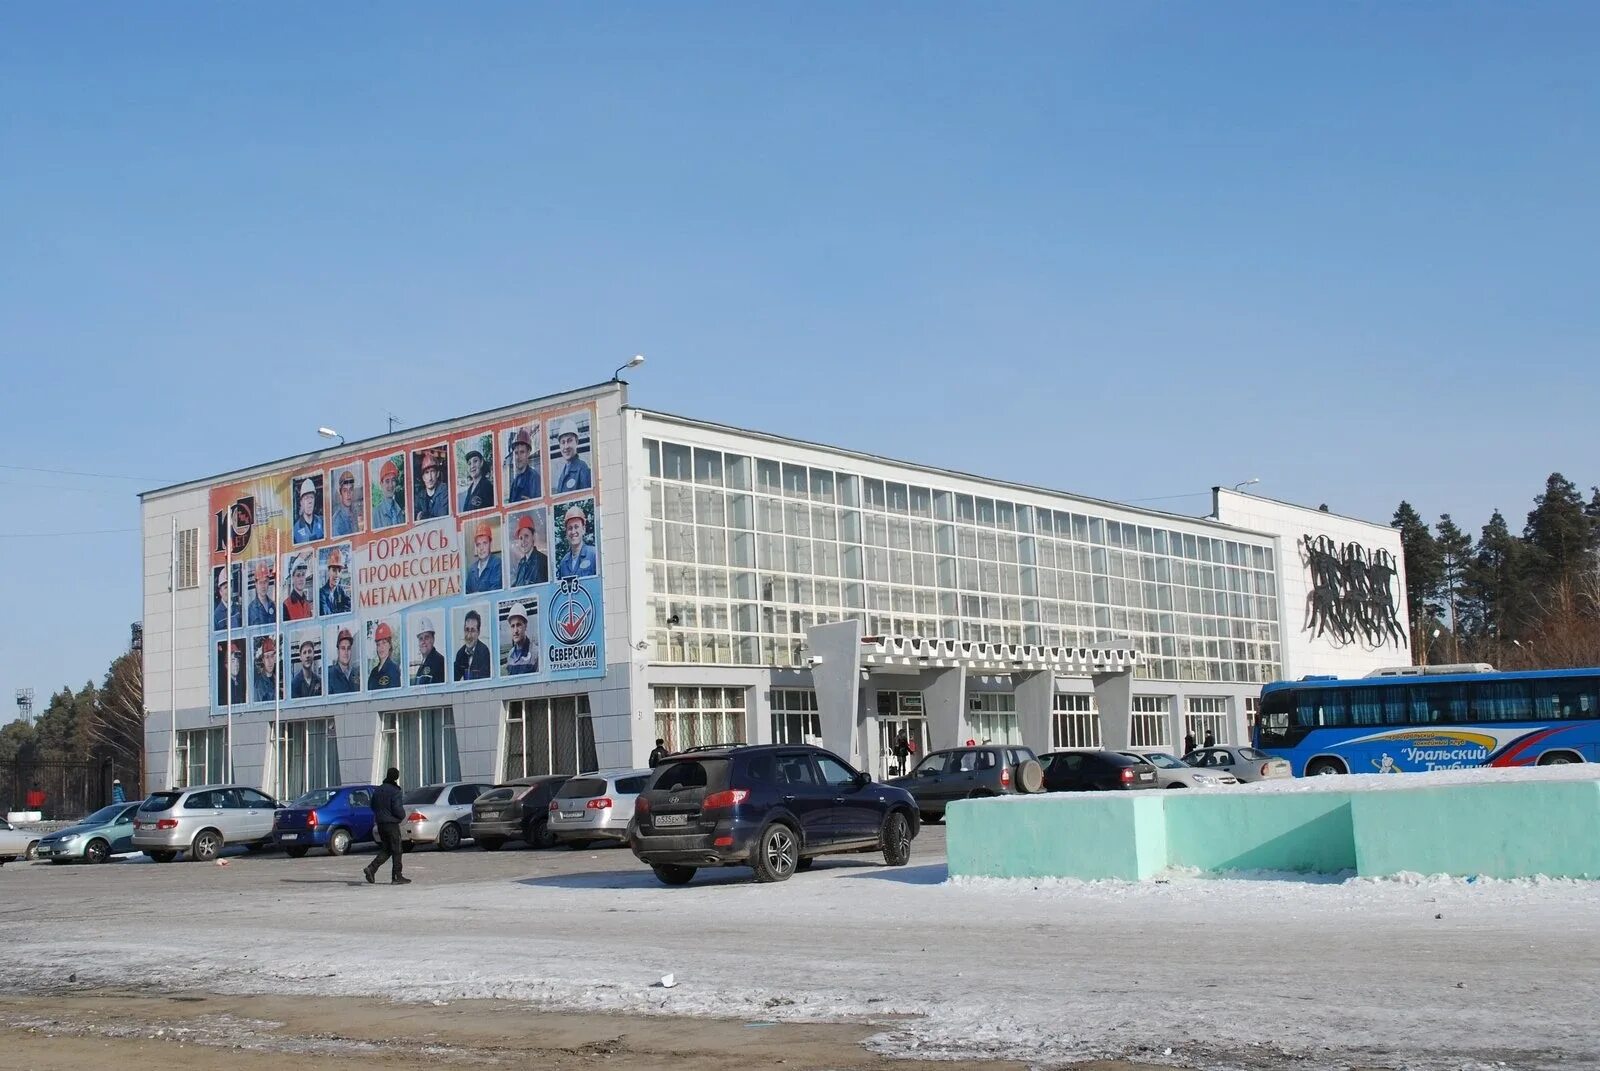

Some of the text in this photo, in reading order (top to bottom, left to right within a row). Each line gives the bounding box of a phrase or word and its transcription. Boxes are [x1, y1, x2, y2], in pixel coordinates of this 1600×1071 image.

[368, 529, 448, 561] ГОРЖУСЬ
[359, 550, 460, 584] ПРОФЕССИЕЙ
[359, 575, 461, 608] МЕТАЛЛУРГА!
[561, 576, 579, 593] СТЗ
[549, 642, 596, 662] СЕВЕРСКИЙ
[550, 660, 597, 670] ТРУБНЫЙ ЗАВОД
